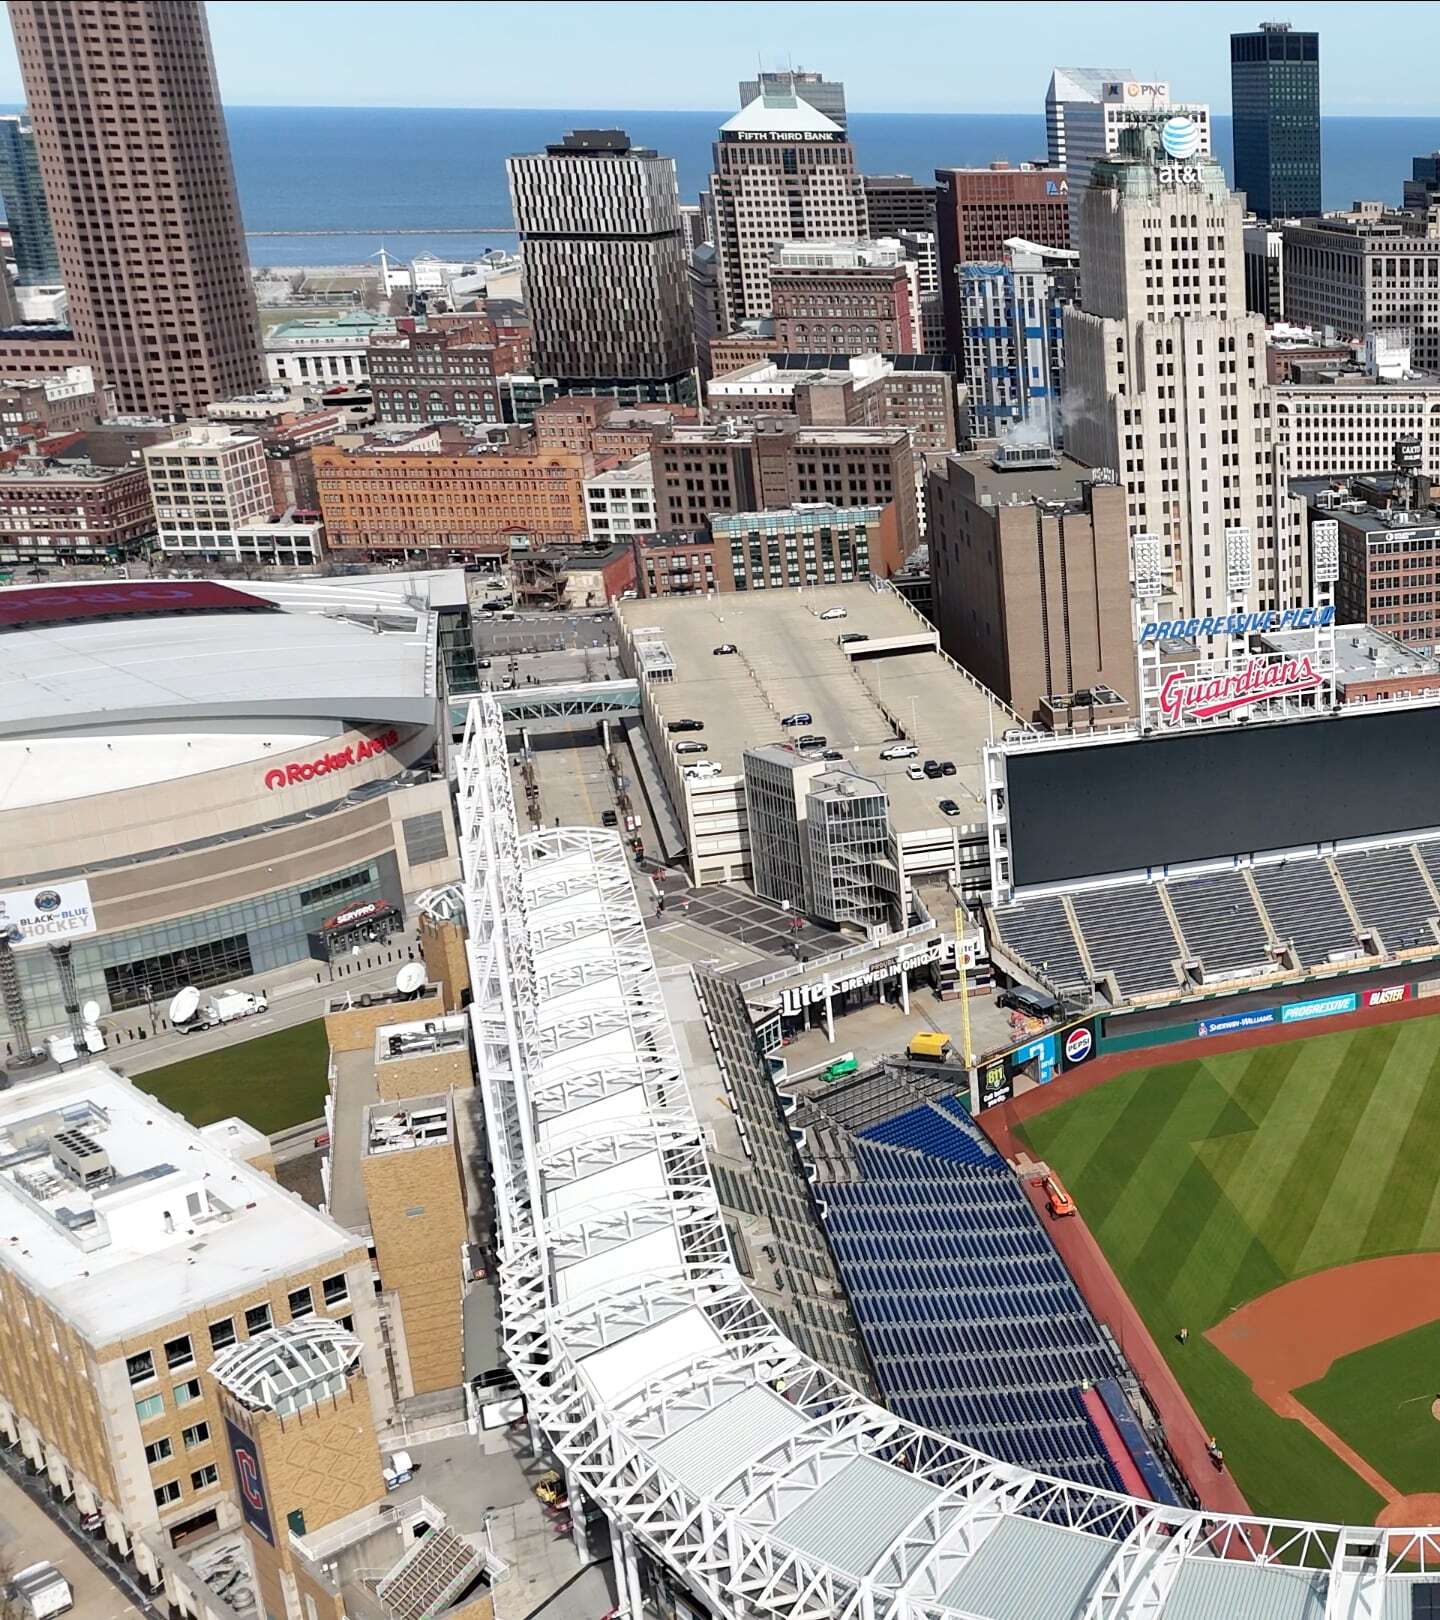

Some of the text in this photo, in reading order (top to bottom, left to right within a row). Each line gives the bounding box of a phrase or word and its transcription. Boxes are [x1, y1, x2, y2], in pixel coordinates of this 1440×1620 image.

[1141, 86, 1165, 96] PNC
[738, 131, 834, 140] FIFTH THIRD BANK
[1159, 161, 1205, 184] at&t
[1138, 605, 1336, 644] PROGRESSIVE FIELD
[1159, 654, 1324, 726] Guardians
[286, 729, 399, 785] Rocket Arena
[20, 914, 53, 926] BLACK
[61, 907, 89, 919] BLUE
[337, 904, 375, 924] SERVPRO
[22, 915, 89, 937] HOCKEY
[841, 968, 888, 992] BREWED
[889, 963, 901, 977] IN
[1369, 988, 1405, 1006] BLASTER
[1283, 997, 1351, 1020] PROGRESSIVE
[1068, 1038, 1090, 1052] PEPSI
